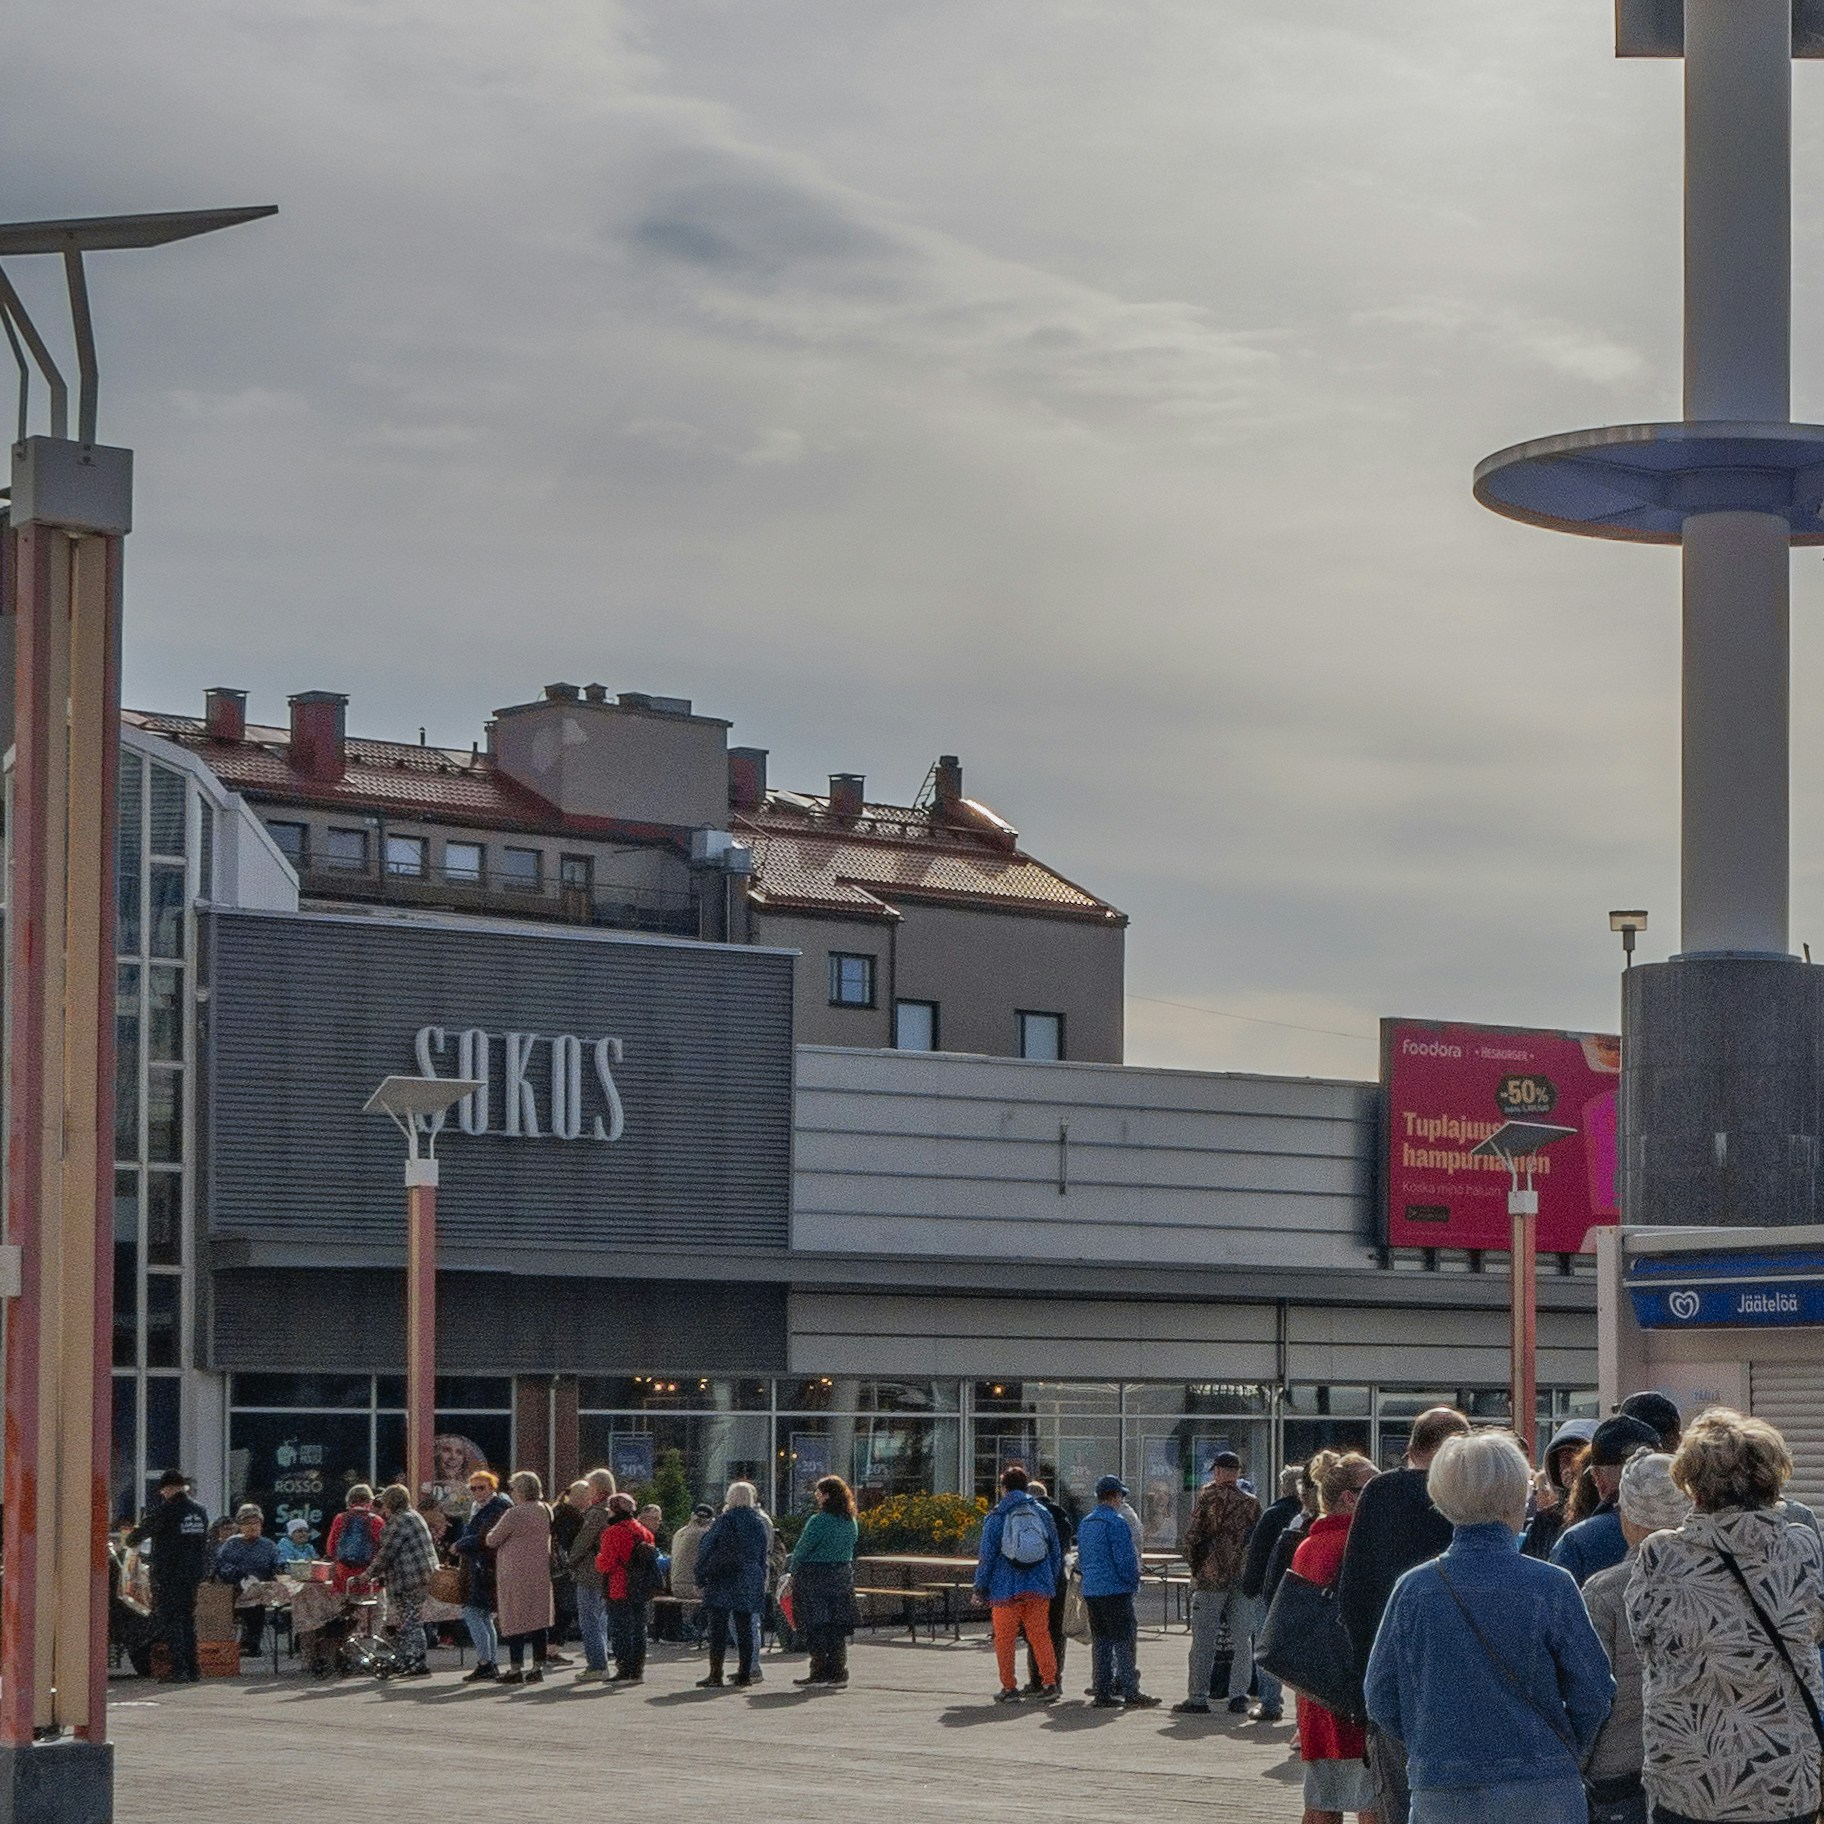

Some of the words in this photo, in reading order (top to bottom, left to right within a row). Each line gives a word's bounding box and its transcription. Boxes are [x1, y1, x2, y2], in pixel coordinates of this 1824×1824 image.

[1402, 1038, 1462, 1057] foodora
[415, 1026, 625, 1141] SOKOS
[1737, 1293, 1798, 1313] Jäätelöä
[275, 1480, 323, 1493] ROSSO
[276, 1504, 323, 1523] Sale
